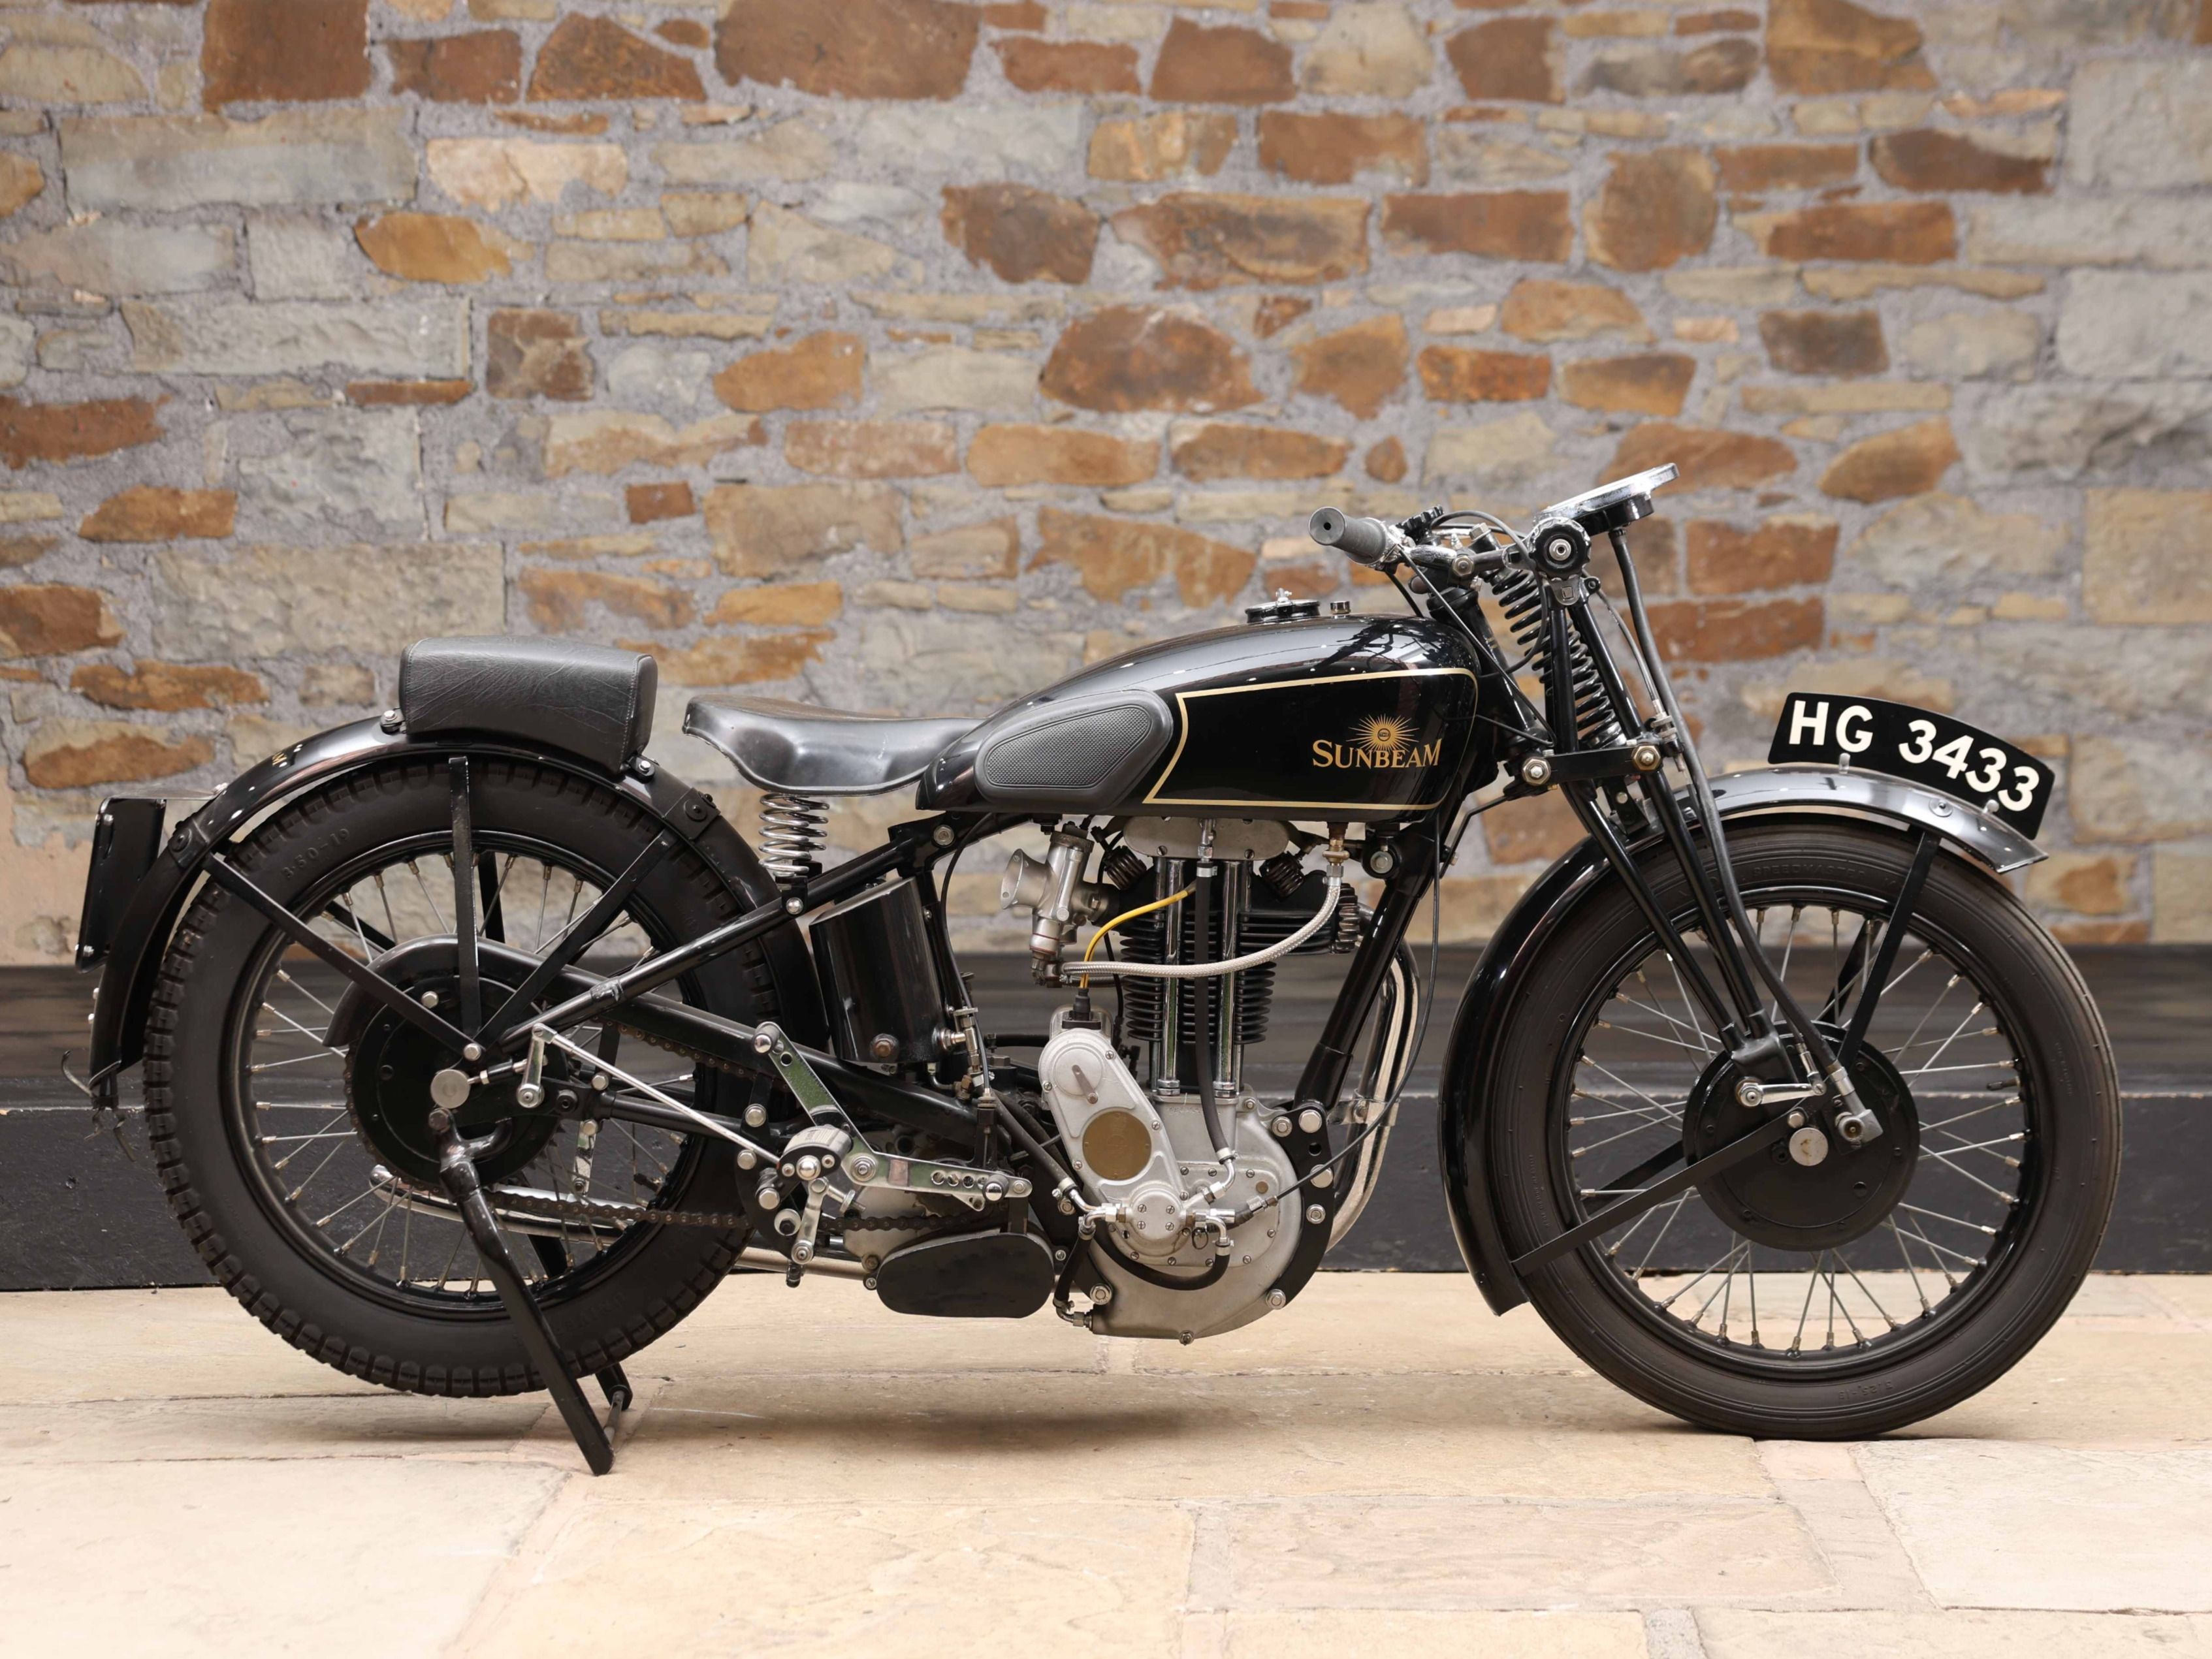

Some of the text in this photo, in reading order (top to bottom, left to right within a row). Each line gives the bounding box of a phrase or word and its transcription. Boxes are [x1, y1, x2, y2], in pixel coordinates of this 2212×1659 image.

[1312, 738, 1442, 769] SUNBEAM
[1788, 700, 2040, 812] HG 3433
